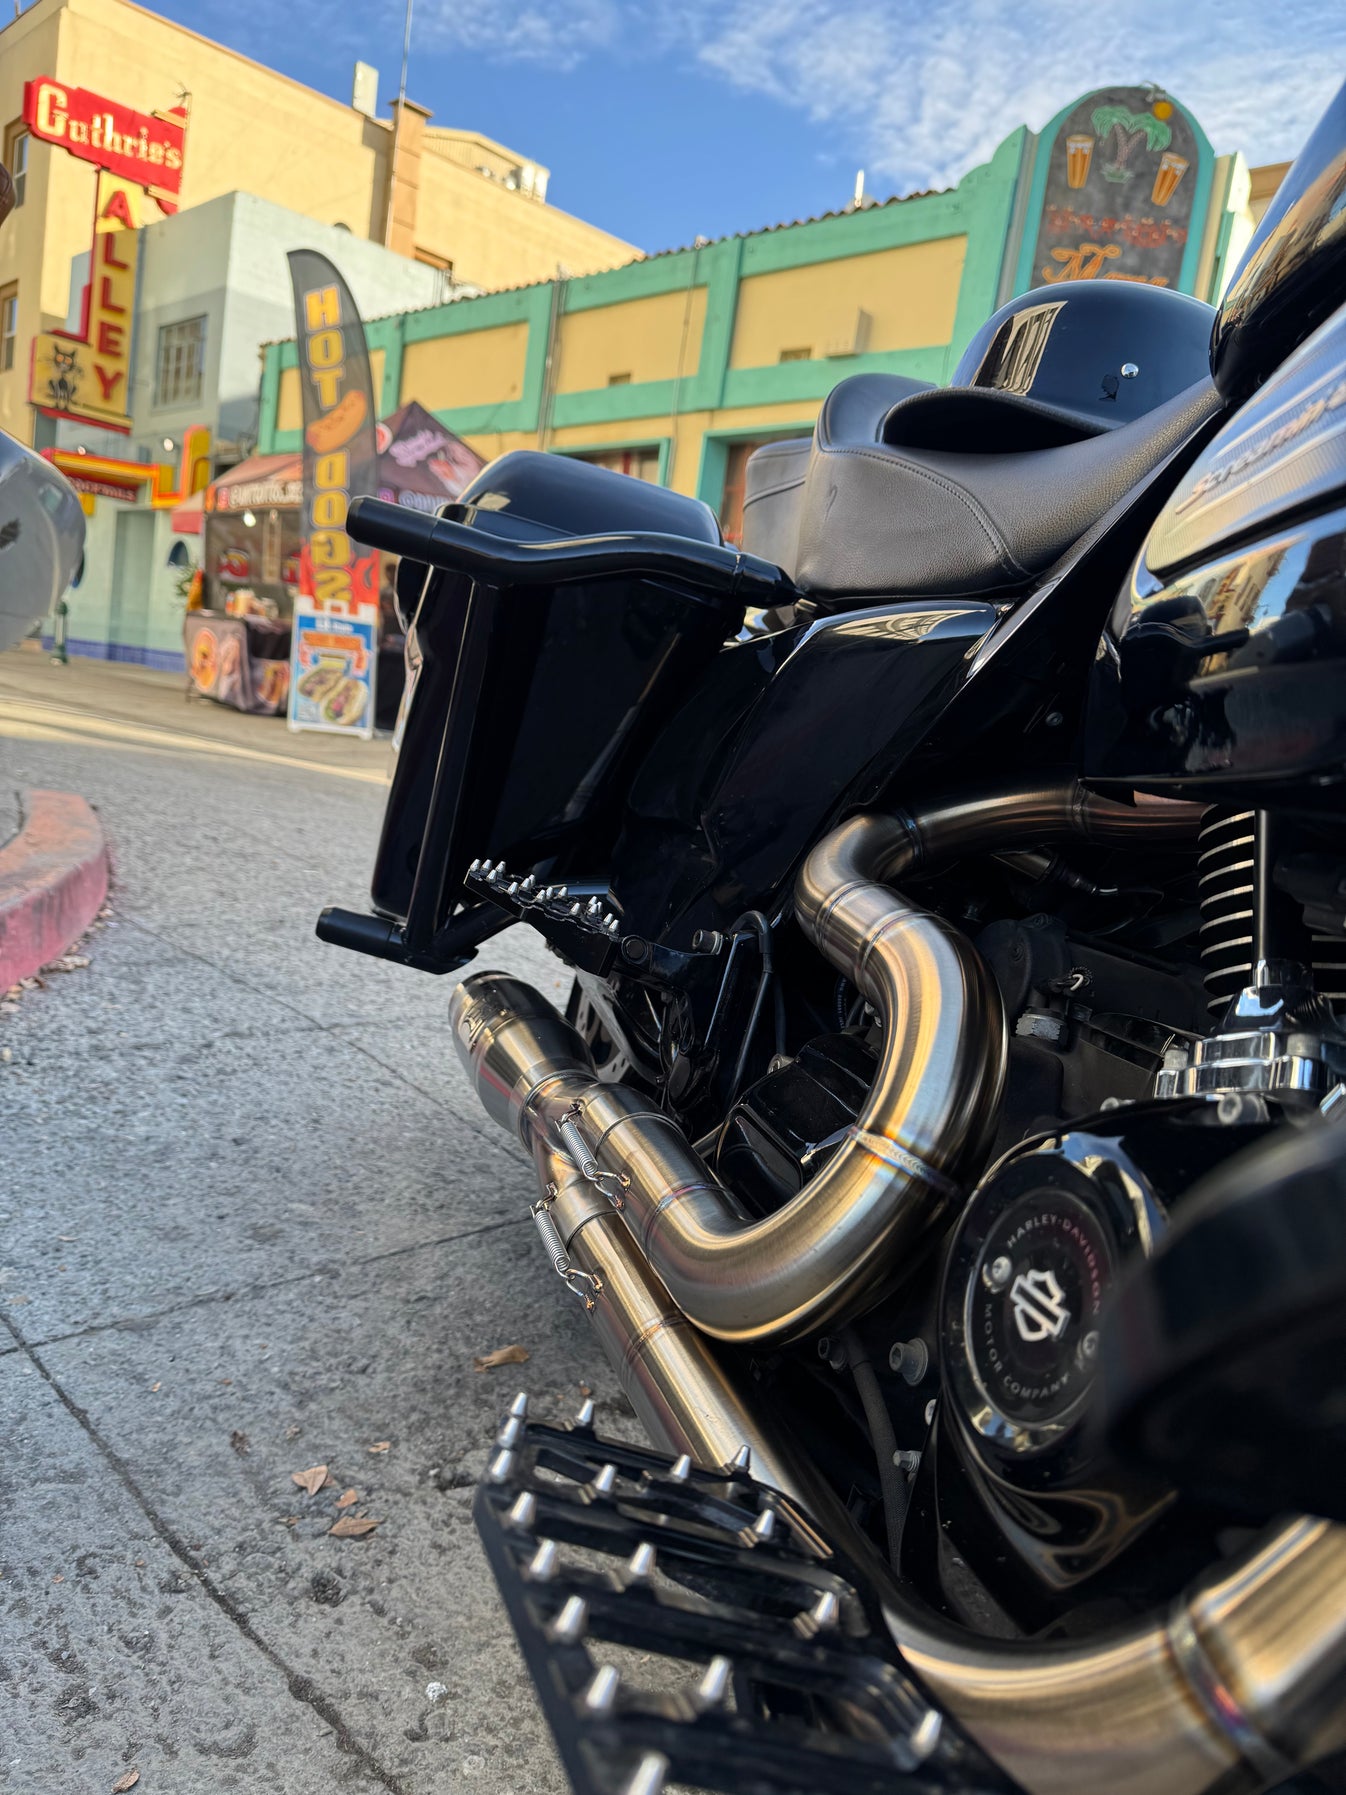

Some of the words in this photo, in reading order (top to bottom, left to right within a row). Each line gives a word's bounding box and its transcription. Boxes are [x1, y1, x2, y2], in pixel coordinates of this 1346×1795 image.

[36, 83, 183, 170] Guthrie's
[94, 190, 136, 402] ALLEY
[984, 1303, 1004, 1375] MOTOR
[1003, 1372, 1071, 1400] COMPANY
